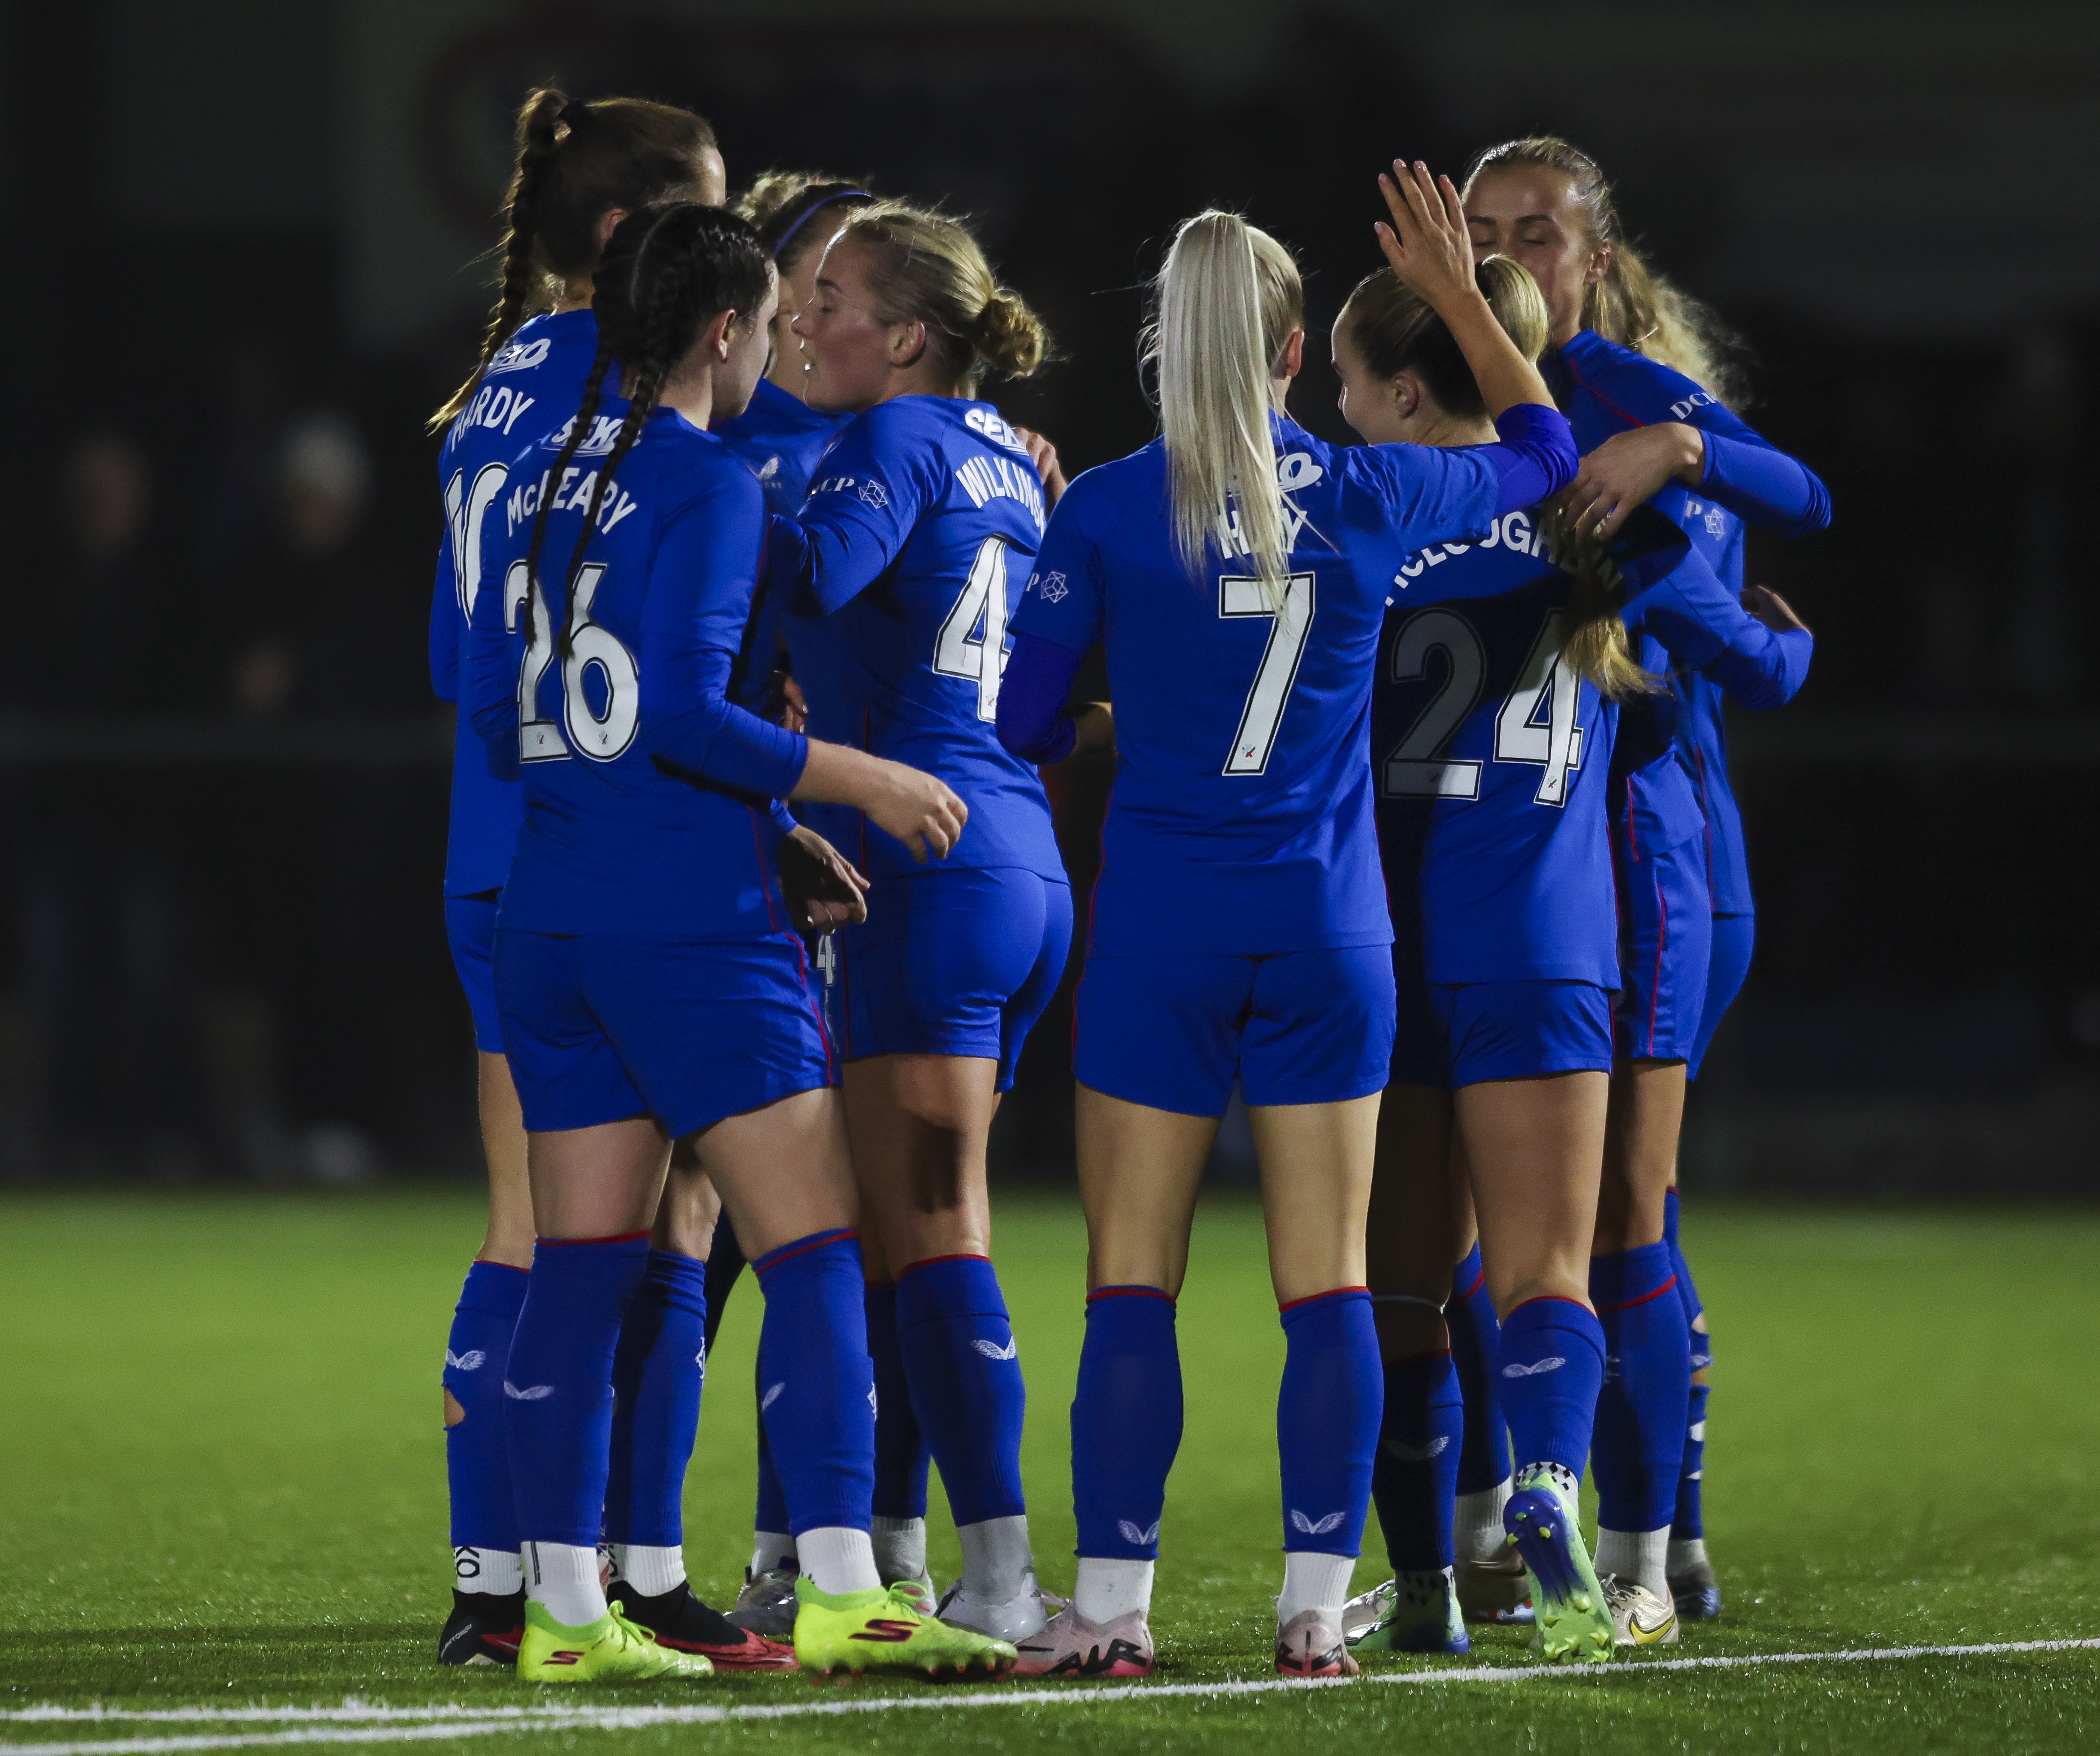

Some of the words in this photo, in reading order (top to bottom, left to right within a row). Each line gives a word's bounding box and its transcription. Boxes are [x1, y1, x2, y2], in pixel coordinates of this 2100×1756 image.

[451, 386, 536, 453] HARDY
[965, 408, 1030, 456] SEK
[932, 533, 1011, 724] 4
[1218, 507, 1308, 560] HY
[504, 559, 639, 763] 26
[1219, 571, 1316, 776] 7
[1382, 607, 1584, 808] 24
